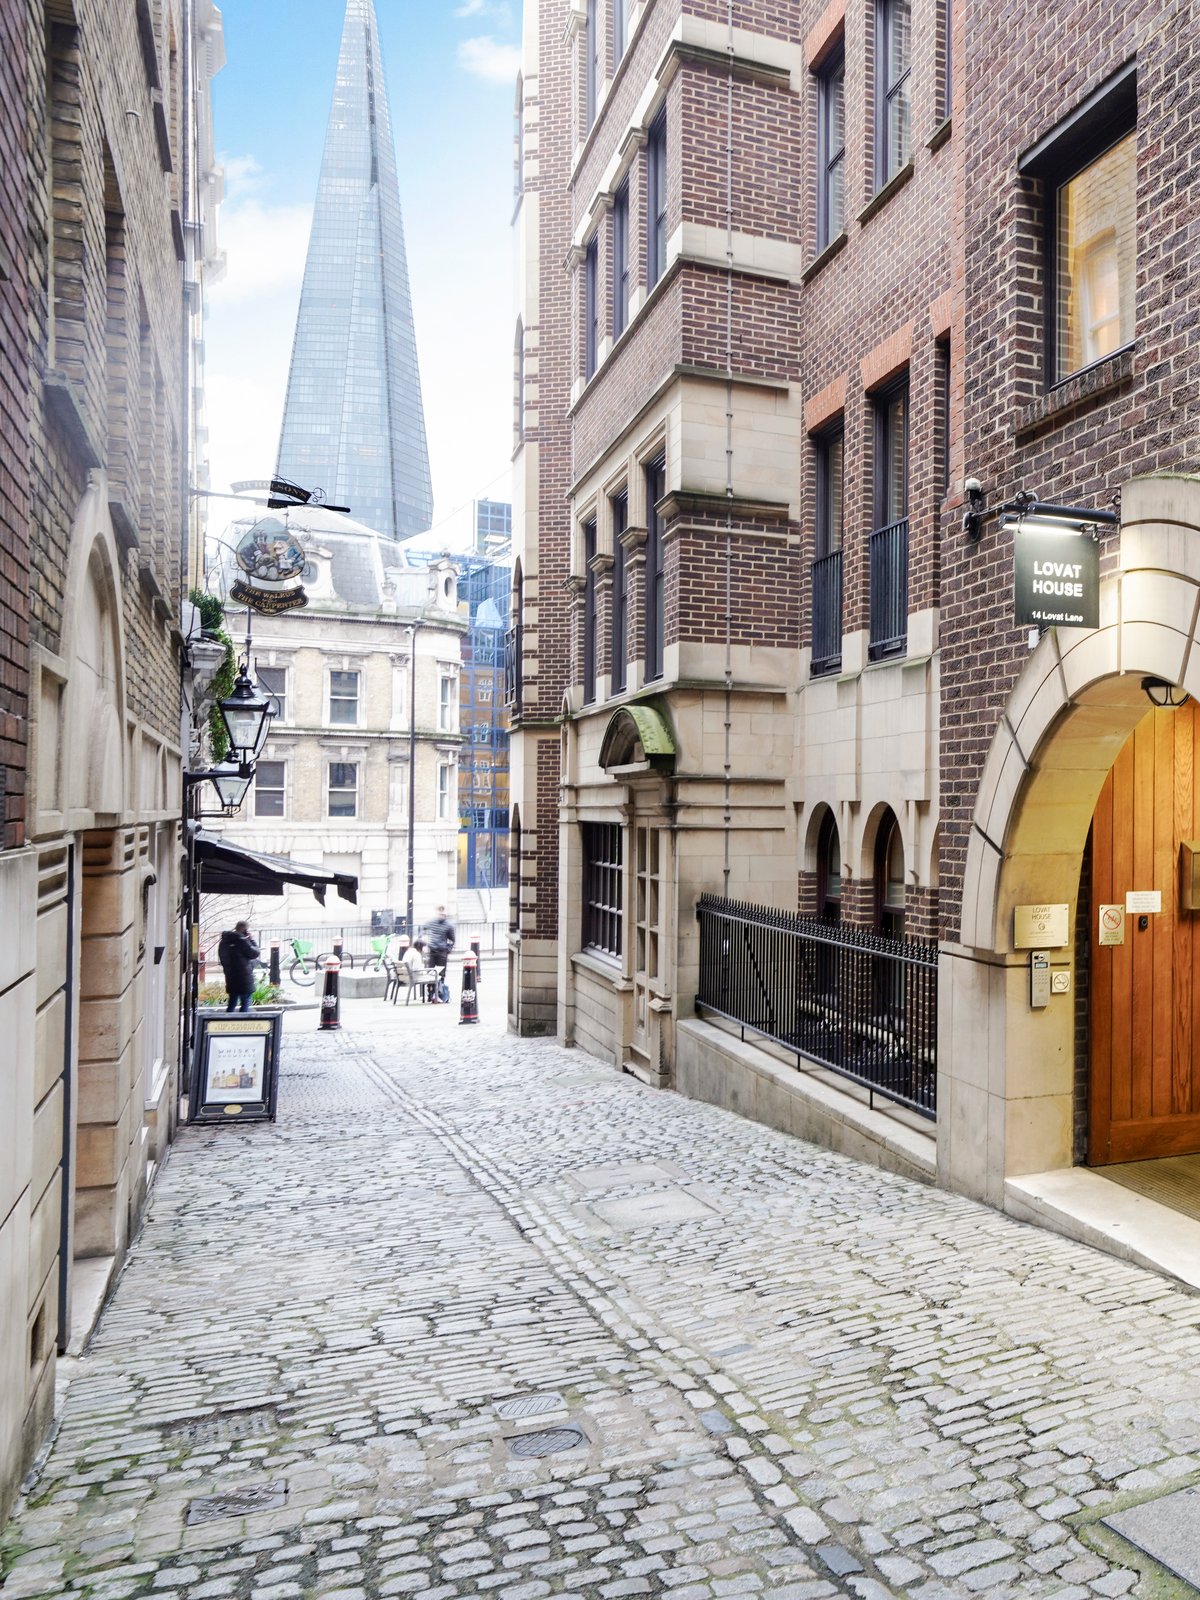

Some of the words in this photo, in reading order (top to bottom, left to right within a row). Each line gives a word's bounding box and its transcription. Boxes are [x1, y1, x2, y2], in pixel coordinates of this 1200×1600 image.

[1033, 560, 1082, 579] LOVAT
[244, 586, 261, 597] THE
[263, 591, 296, 599] WALRUS
[1032, 579, 1083, 597] HOUSE
[237, 592, 254, 603] THE
[1031, 610, 1041, 619] 14
[1042, 611, 1064, 621] Lovat
[1065, 612, 1084, 622] Lane
